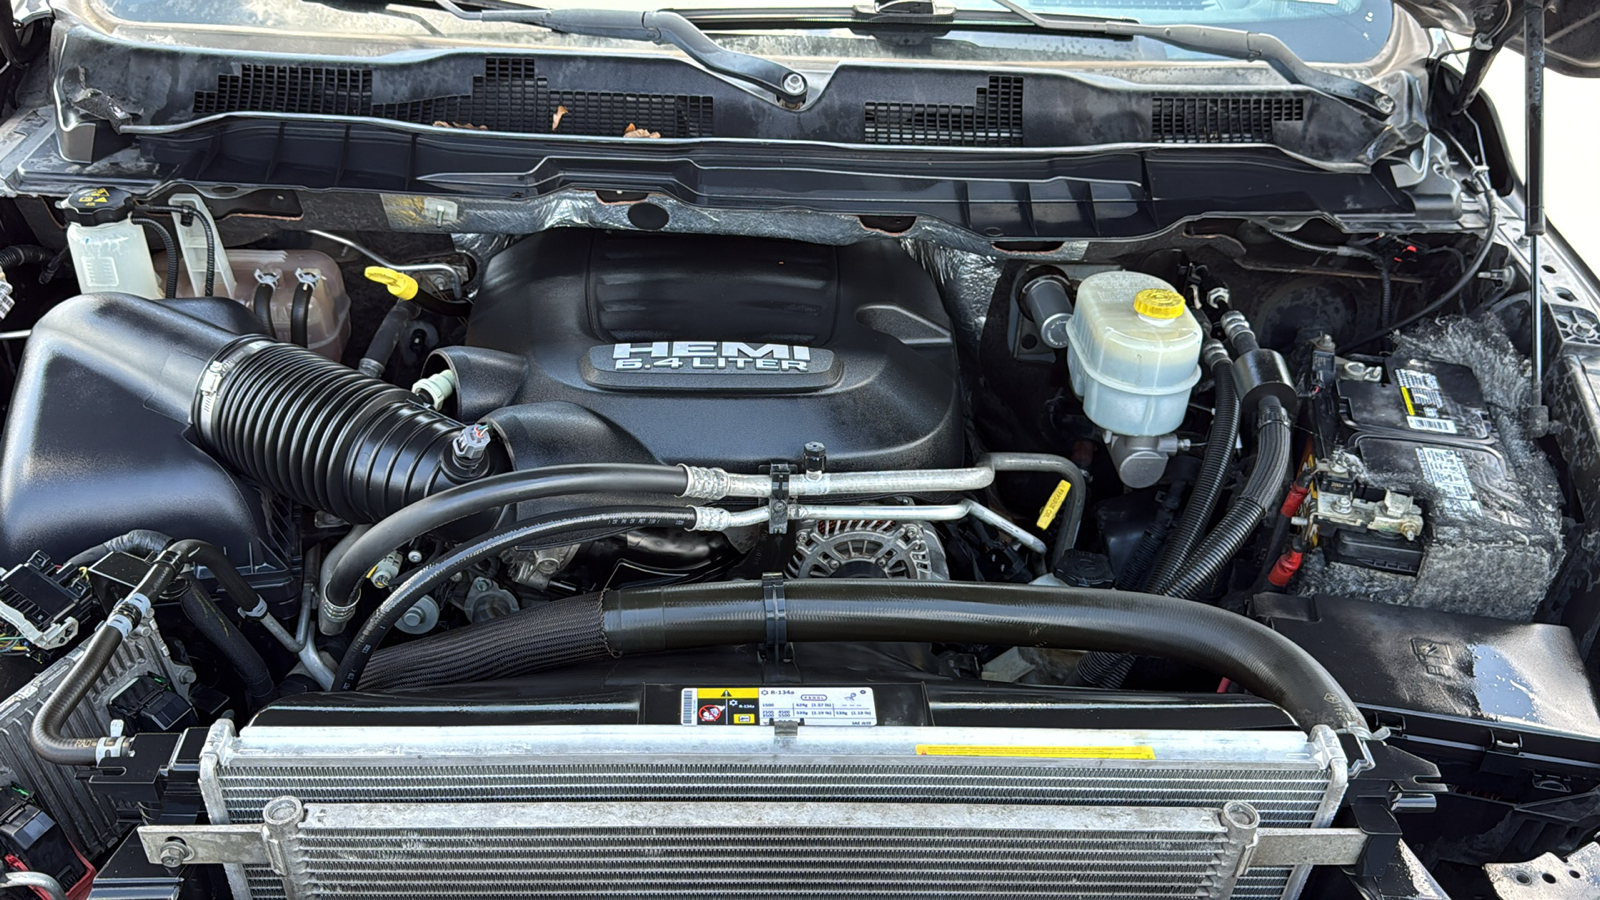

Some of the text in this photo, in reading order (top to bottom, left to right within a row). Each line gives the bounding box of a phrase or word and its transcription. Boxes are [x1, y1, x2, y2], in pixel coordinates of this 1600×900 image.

[612, 341, 811, 361] HEMI
[615, 357, 809, 372] 6.4 LITER
